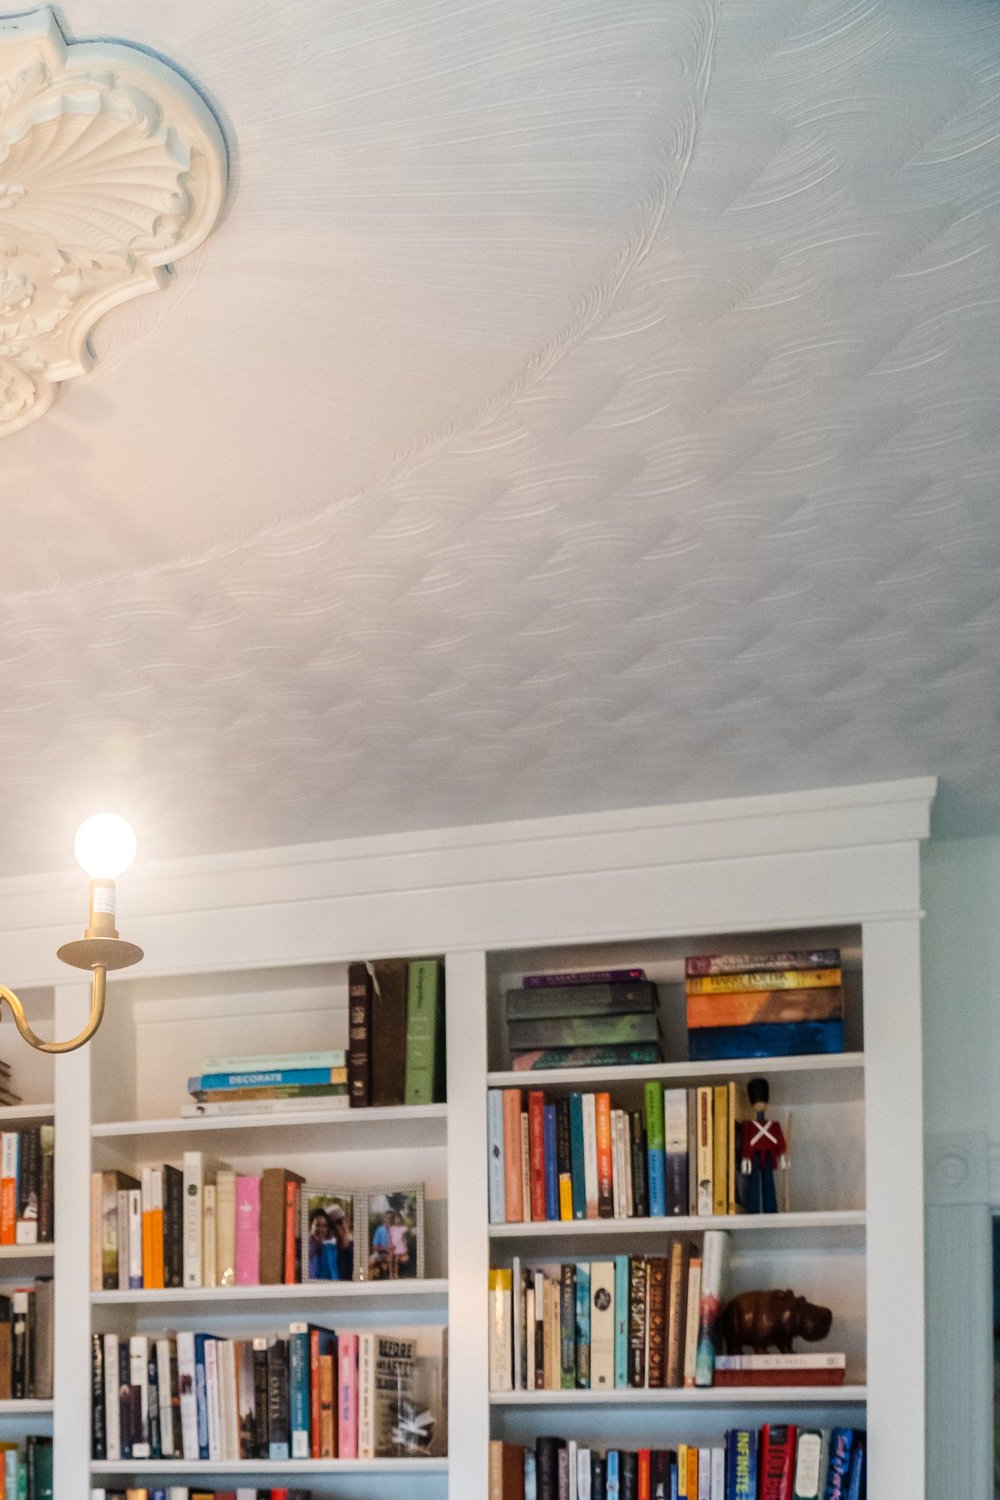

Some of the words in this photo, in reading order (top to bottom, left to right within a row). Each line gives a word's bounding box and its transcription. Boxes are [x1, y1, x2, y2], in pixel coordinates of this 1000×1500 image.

[228, 1072, 282, 1085] DECORATE
[630, 1302, 645, 1349] SMITH
[735, 1431, 749, 1494] INFINITE
